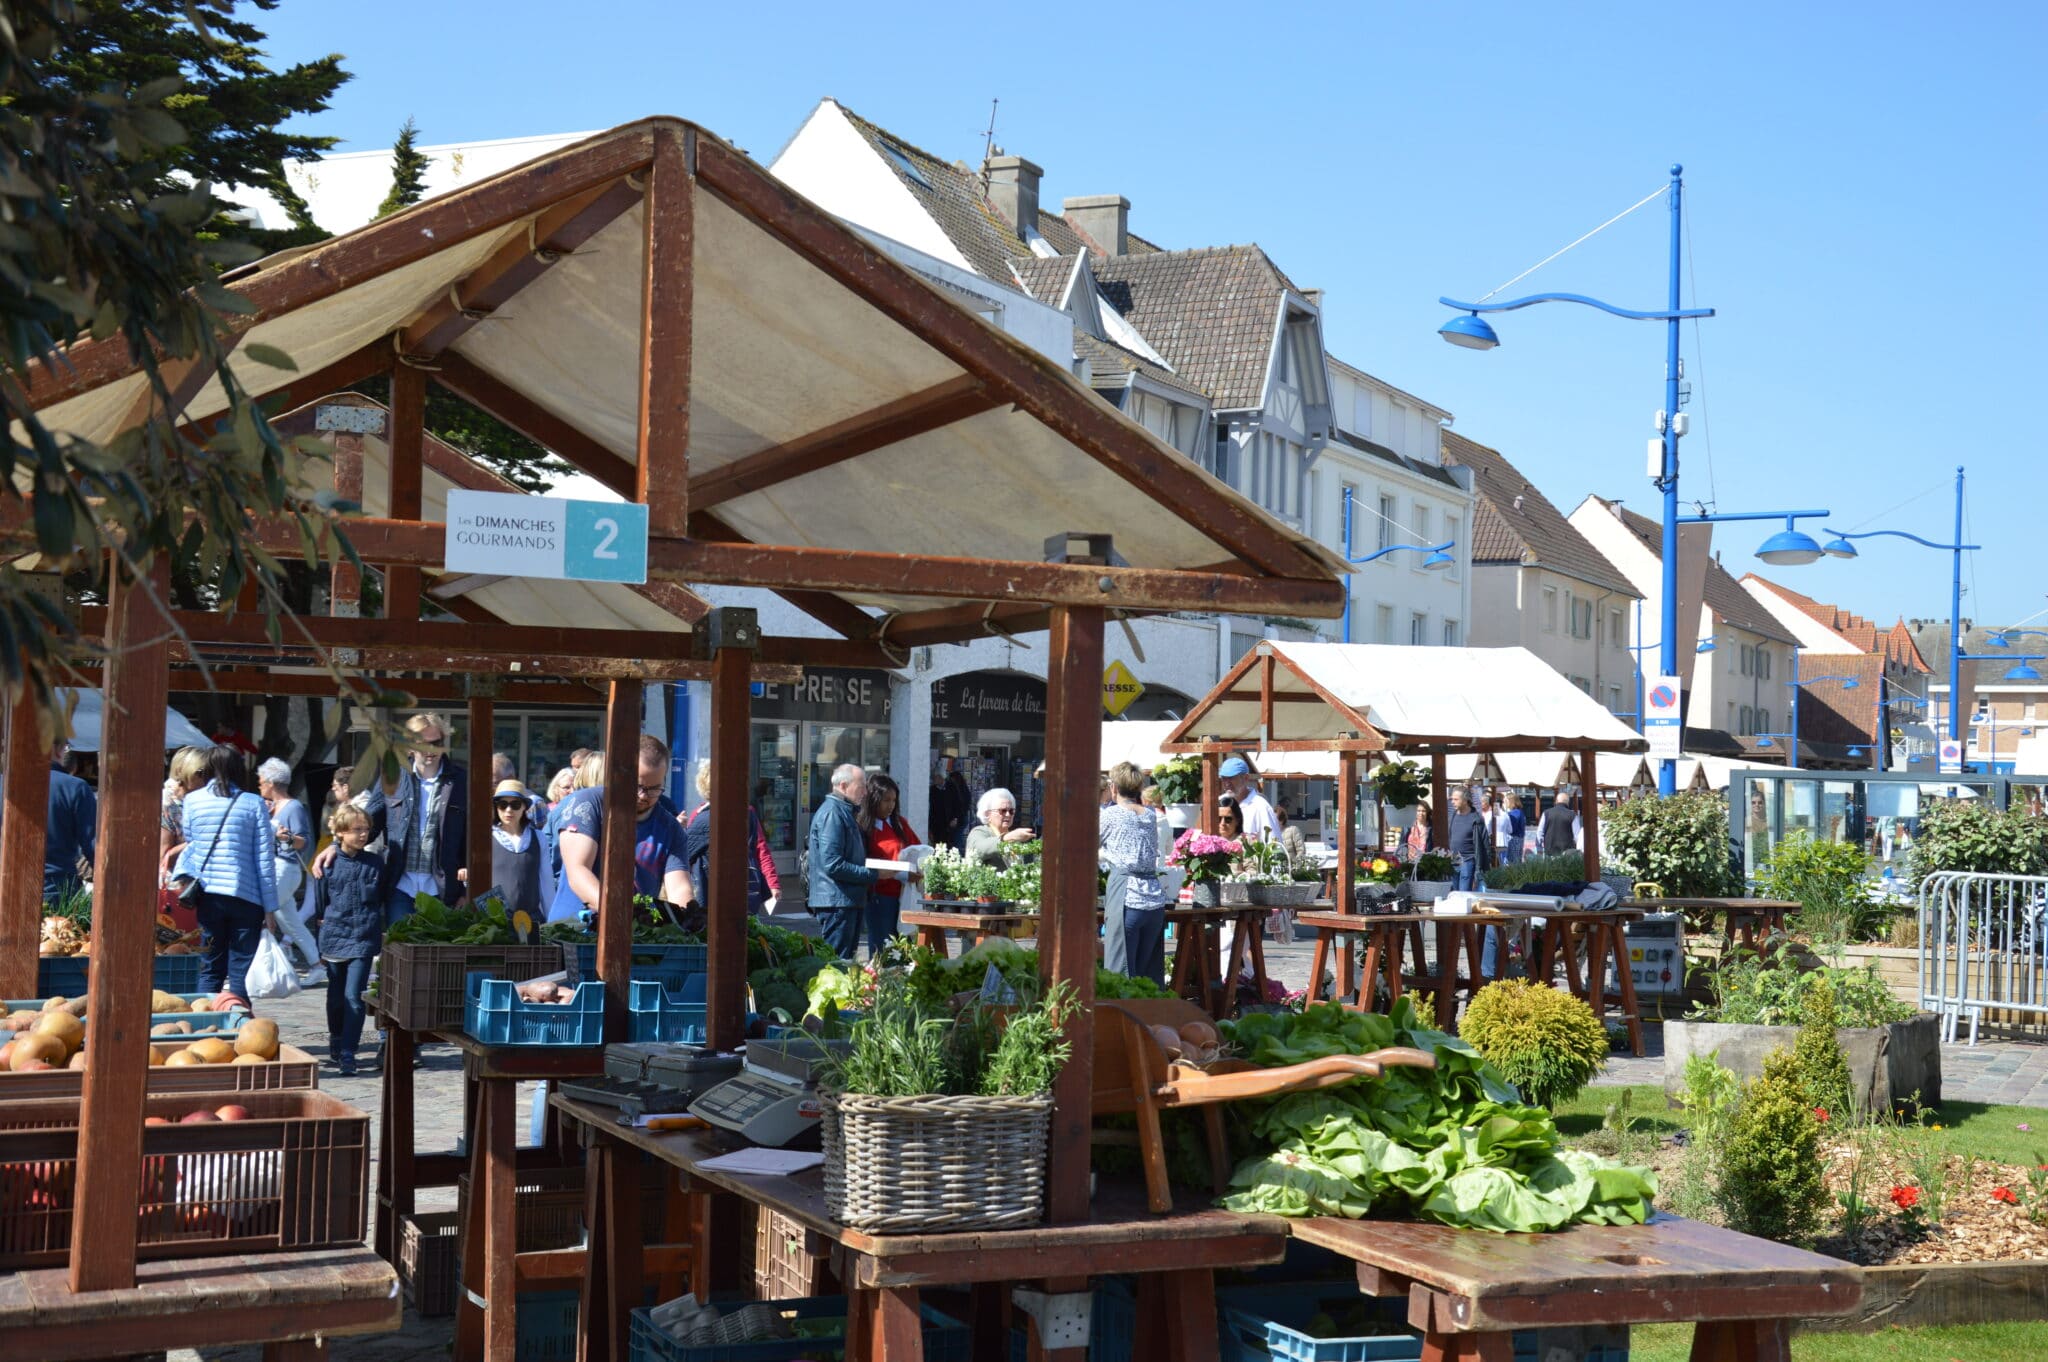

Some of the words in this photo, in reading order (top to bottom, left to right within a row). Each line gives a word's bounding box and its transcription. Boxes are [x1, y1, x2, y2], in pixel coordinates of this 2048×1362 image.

[475, 515, 555, 533] DIMANCHES
[592, 517, 619, 560] 2
[456, 531, 556, 550] GOURMANDS
[794, 675, 872, 705] PRESSE
[959, 687, 975, 709] La
[977, 689, 1009, 718] fureur
[1011, 691, 1023, 713] de
